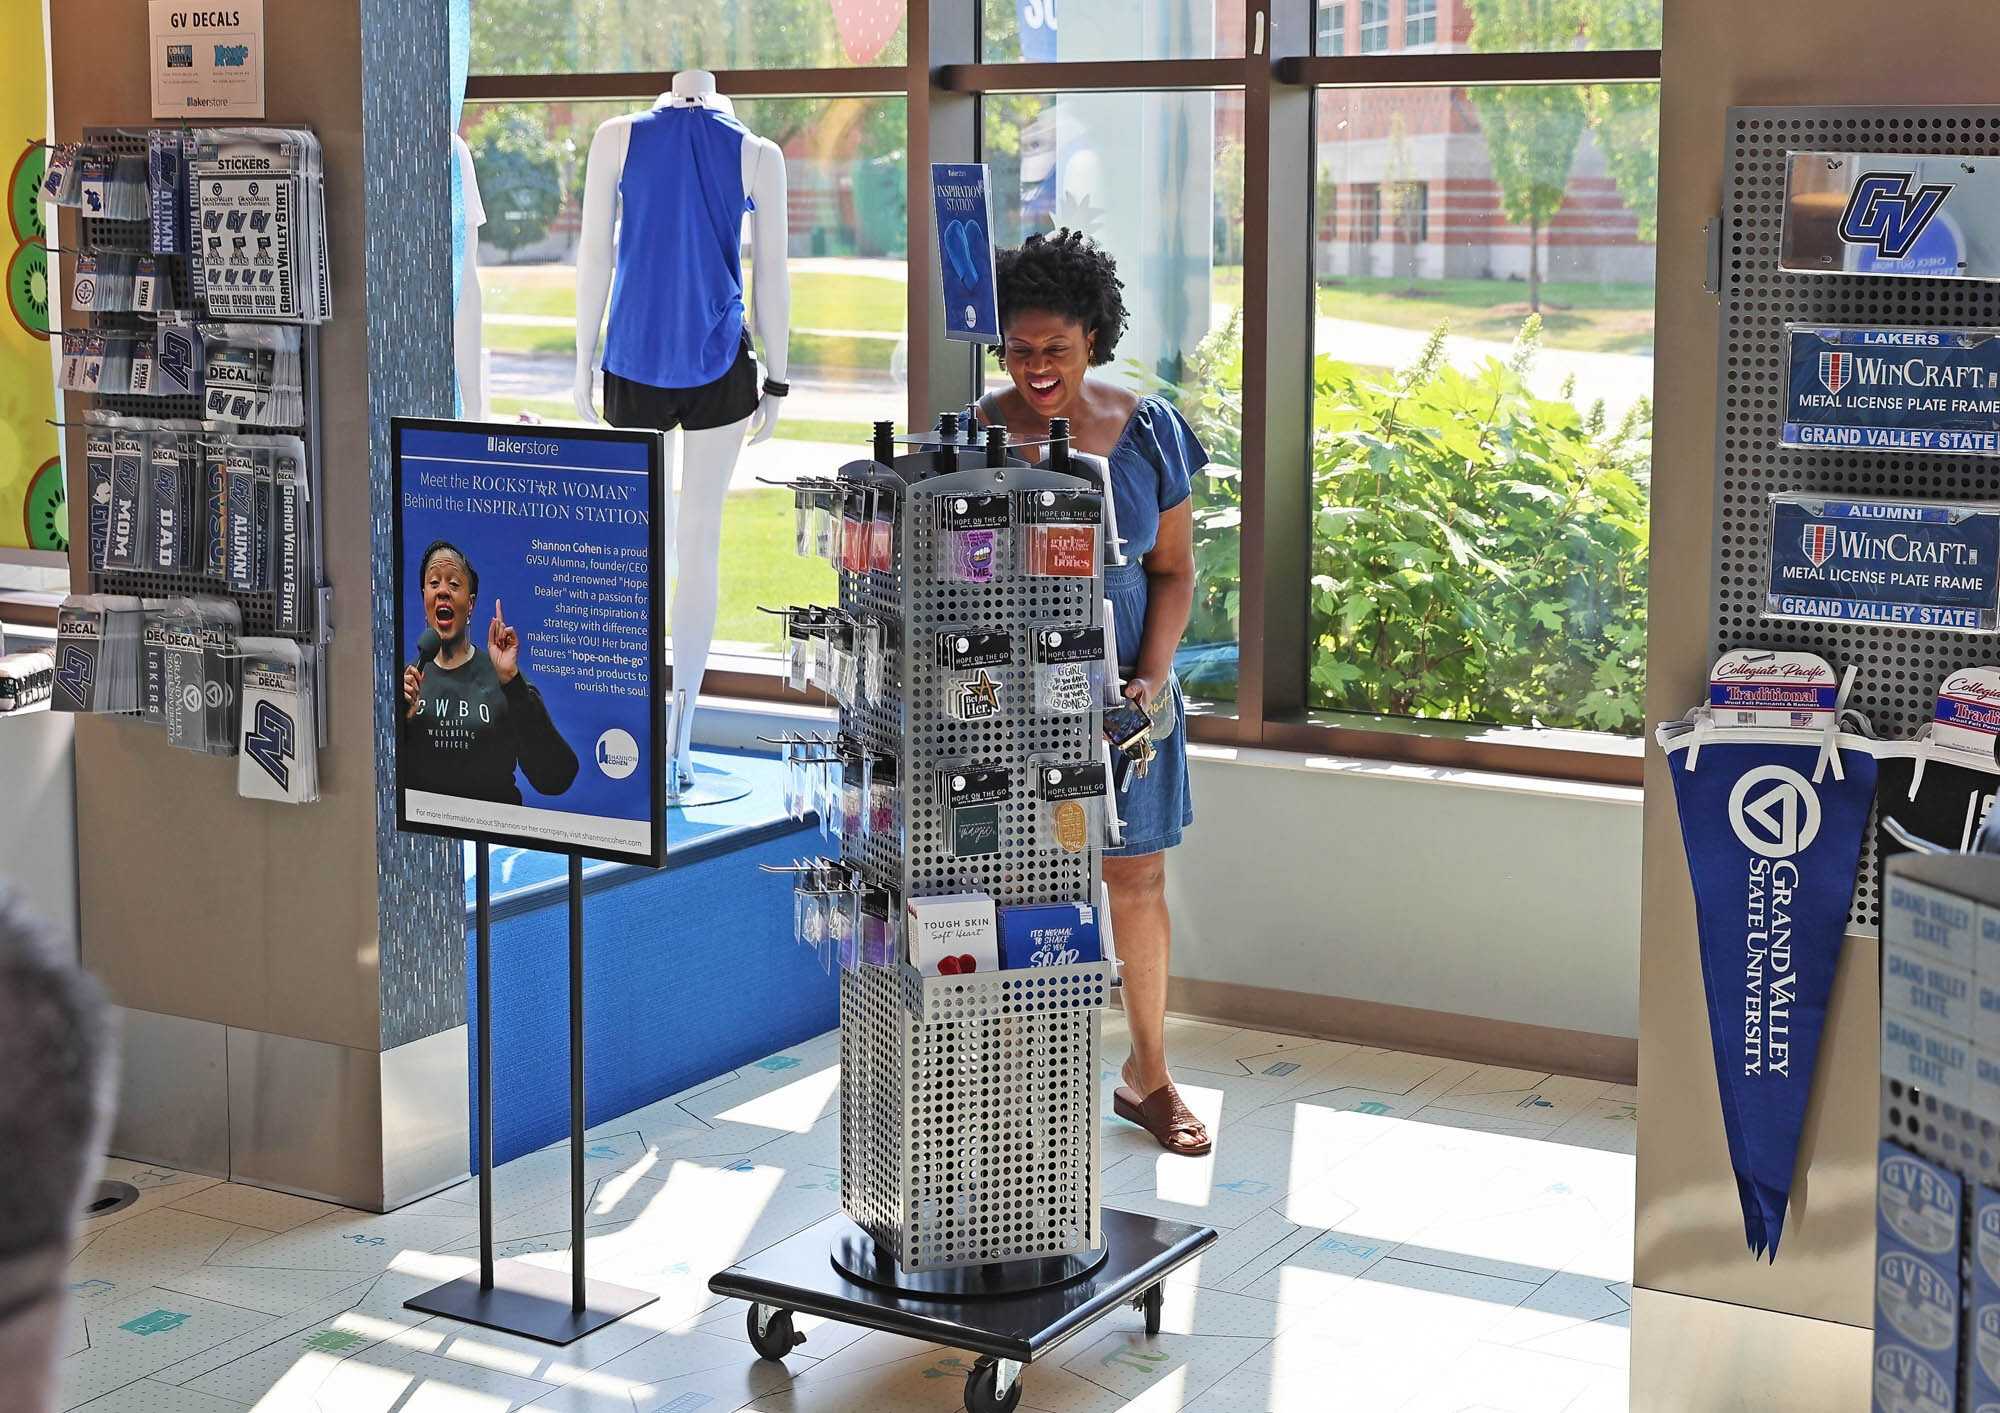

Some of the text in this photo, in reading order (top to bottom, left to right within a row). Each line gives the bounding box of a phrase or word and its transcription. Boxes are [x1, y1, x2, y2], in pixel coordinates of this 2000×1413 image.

[171, 11, 240, 28] GV DECALS
[218, 158, 270, 170] STICKERS
[937, 184, 981, 198] INSPIRATION
[946, 199, 975, 211] STATION
[1837, 171, 1957, 261] GV
[275, 183, 291, 314] GRAND VALLEY STATE
[1864, 333, 1939, 346] LAKERS
[209, 367, 251, 381] DECAL
[1799, 394, 2000, 413] METAL LICENSE PLATE FRAME
[115, 442, 140, 452] DECAL
[1801, 427, 1995, 449] GRAND VALLEY STATE
[88, 443, 112, 454] DECAL
[153, 450, 178, 461] DECAL
[227, 458, 252, 468] DECAL
[420, 472, 447, 489] Meet
[450, 474, 469, 489] the
[284, 486, 294, 532] GRAND
[404, 493, 649, 526] Behind the INSPIRATION STATION
[1849, 505, 1922, 520] ALUMNI
[115, 499, 131, 557] MOM
[159, 509, 173, 566] DAD
[233, 514, 248, 579] ALUMNI
[532, 539, 648, 558] Shannon Cohen is a proud
[283, 533, 295, 581] VALLEY
[526, 555, 648, 574] GVSU Alumna, founder/CEO
[552, 573, 569, 583] and
[573, 575, 616, 586] renowned
[1783, 566, 1982, 590] METAL LICENSE PLATE FRAME
[569, 589, 588, 600] with
[590, 592, 596, 600] a
[599, 593, 632, 604] passion
[635, 594, 648, 605] for
[555, 603, 648, 620] sharing inspiration &
[1782, 597, 1975, 627] GRAND VALLEY STATE
[61, 623, 97, 635] DECAL
[543, 618, 648, 636] strategy with difference
[167, 635, 200, 649] DECAL
[527, 632, 648, 651] makers like YOU! Her brand
[530, 646, 566, 658] features
[532, 663, 648, 682] messages and products to
[1717, 662, 1825, 682] Collegiate Pacific
[149, 652, 158, 713] LAKERS
[258, 677, 285, 689] DECAL
[575, 682, 649, 697] nourish the soul.
[1948, 678, 2000, 700] Collegia
[1726, 686, 1818, 702] Traditional
[416, 808, 425, 816] For
[427, 810, 441, 819] more
[442, 812, 475, 824] information
[476, 817, 493, 827] about
[493, 820, 521, 831] Shannon
[528, 825, 538, 833] her
[570, 831, 582, 840] visit
[582, 833, 642, 848] shannoncohen.com
[1748, 857, 1770, 928] STATE
[924, 918, 989, 930] TOUGH SKIN
[931, 931, 952, 944] Soft
[1769, 860, 1798, 1078] GRAND VALLEY
[1886, 1162, 1949, 1206] GVSU
[1885, 1260, 1949, 1305] GVSU
[1881, 1351, 1947, 1400] GVSU
